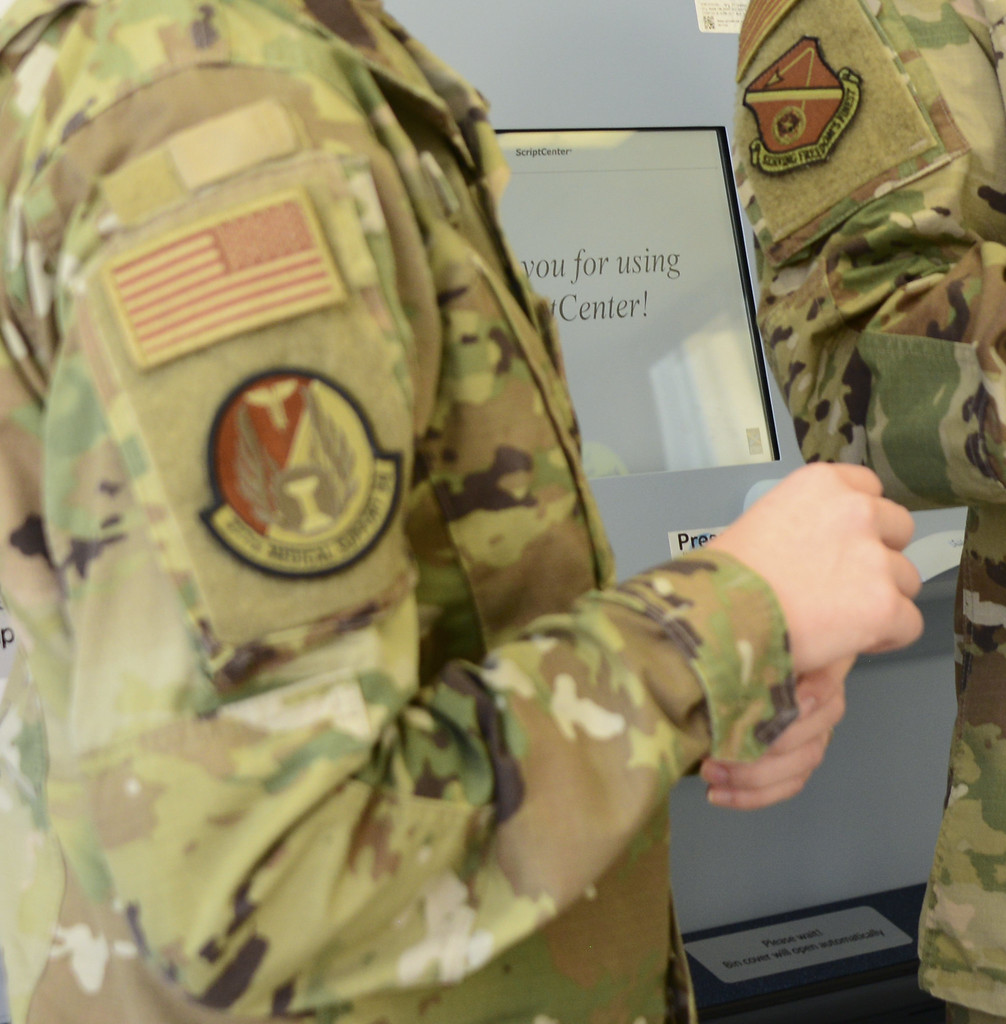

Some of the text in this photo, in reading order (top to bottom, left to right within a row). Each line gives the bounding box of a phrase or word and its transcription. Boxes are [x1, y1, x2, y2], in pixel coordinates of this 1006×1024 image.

[521, 248, 681, 284] you for using
[722, 928, 886, 970] Bin cover will open automatically
[761, 935, 797, 949] Please
